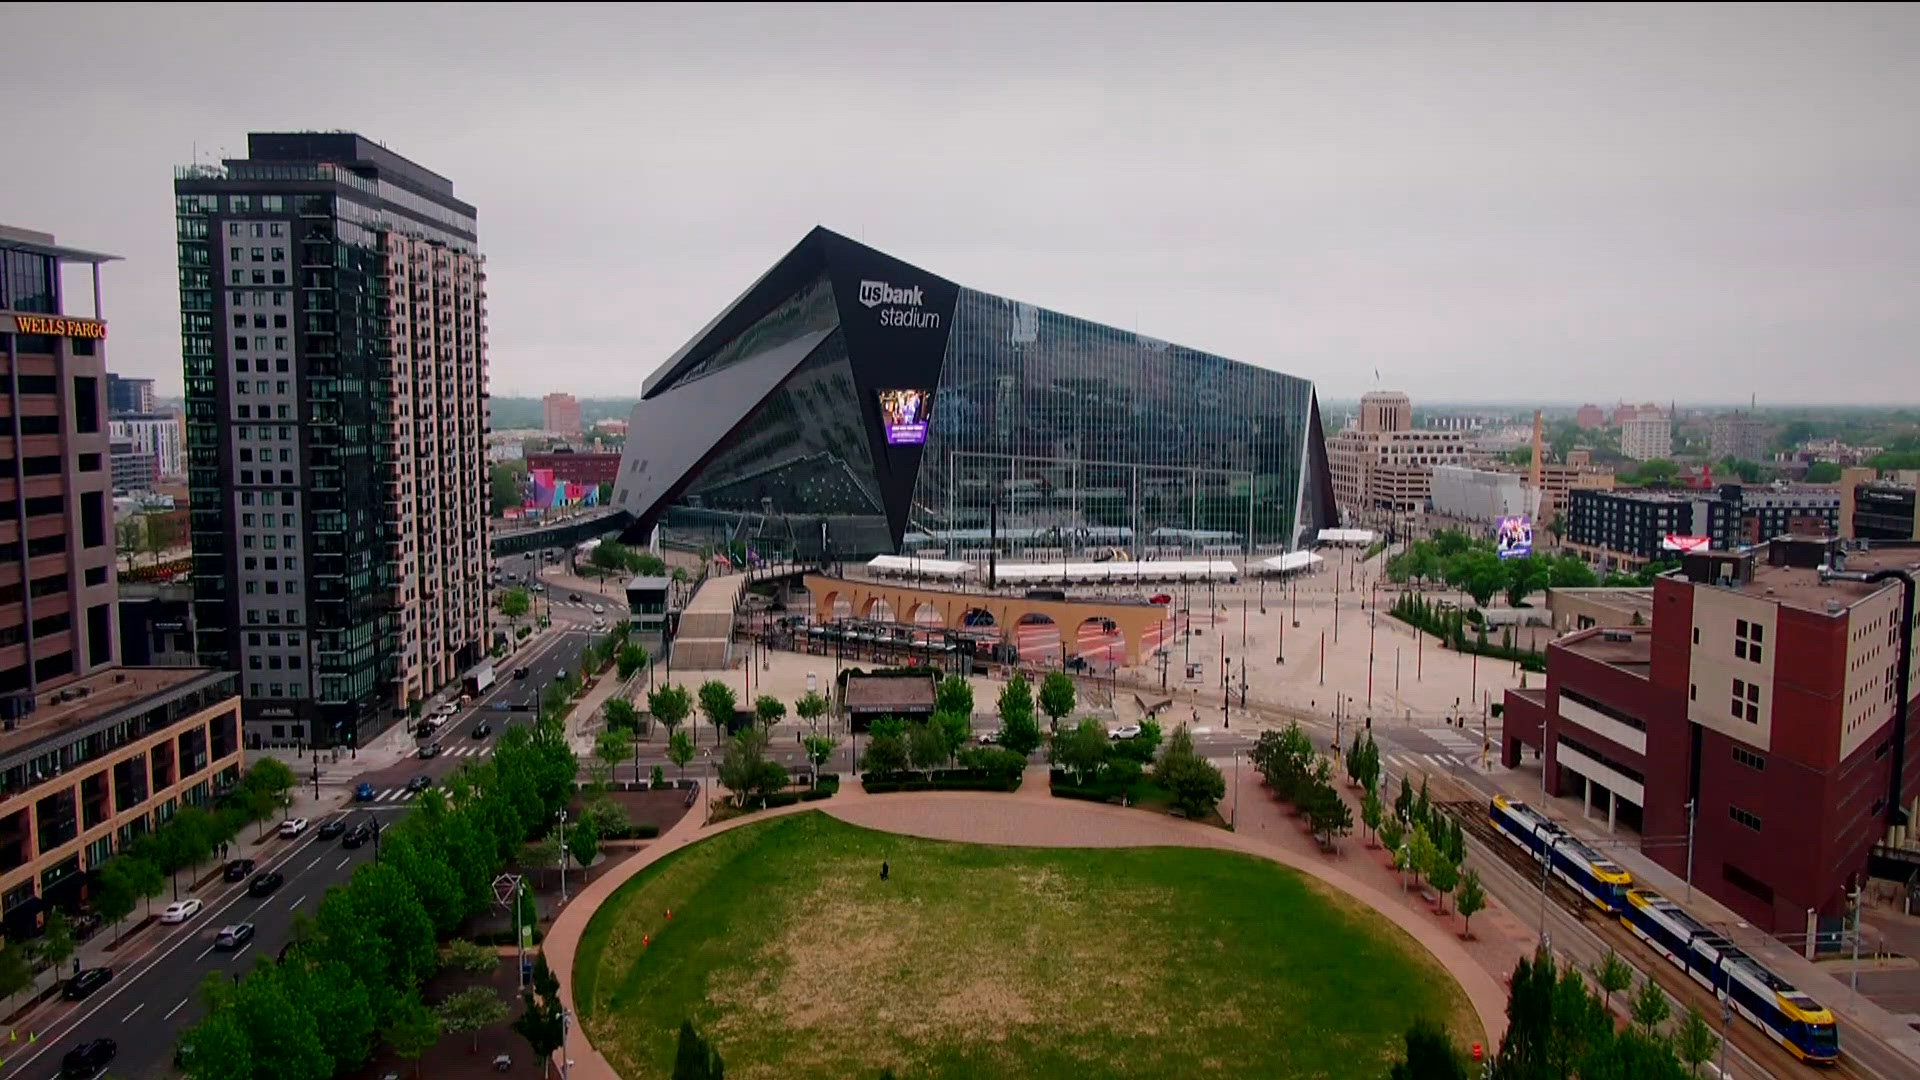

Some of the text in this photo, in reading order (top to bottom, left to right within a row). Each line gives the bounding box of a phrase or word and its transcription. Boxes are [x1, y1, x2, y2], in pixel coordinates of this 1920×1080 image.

[17, 316, 106, 339] WELLS FARGO
[880, 307, 940, 328] stadium
